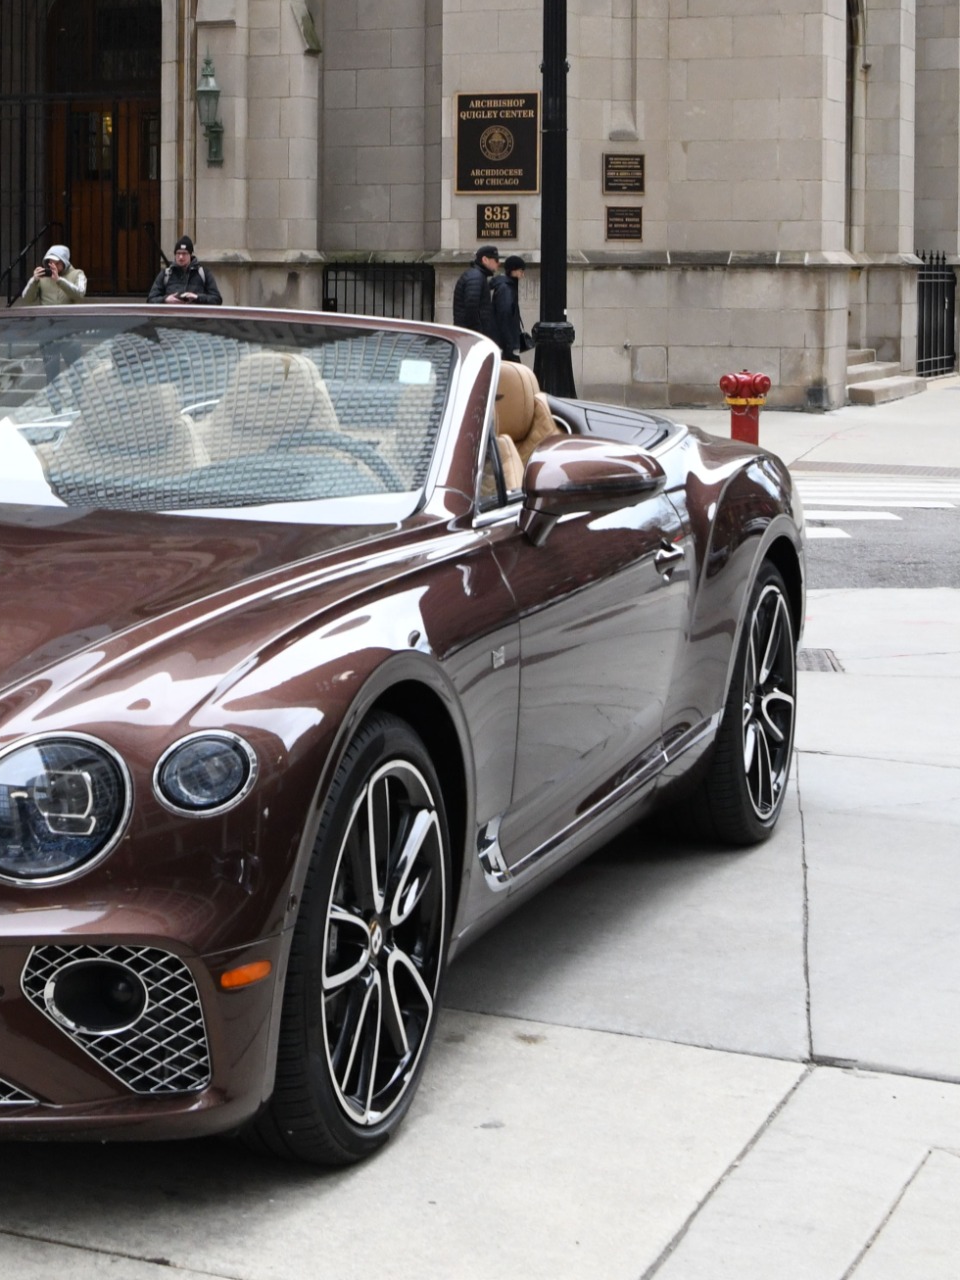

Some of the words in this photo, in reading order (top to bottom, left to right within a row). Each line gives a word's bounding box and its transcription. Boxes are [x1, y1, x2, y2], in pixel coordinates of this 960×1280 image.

[469, 99, 526, 108] ARCHBISHOP
[460, 110, 498, 120] QUIGLEY
[499, 109, 535, 118] CENTER
[470, 168, 524, 177] ARCHDIOCESE
[474, 178, 485, 186] OF
[486, 178, 520, 186] CHICAGO
[484, 206, 510, 221] 835
[485, 221, 509, 229] NORTH
[481, 229, 501, 237] RUSH
